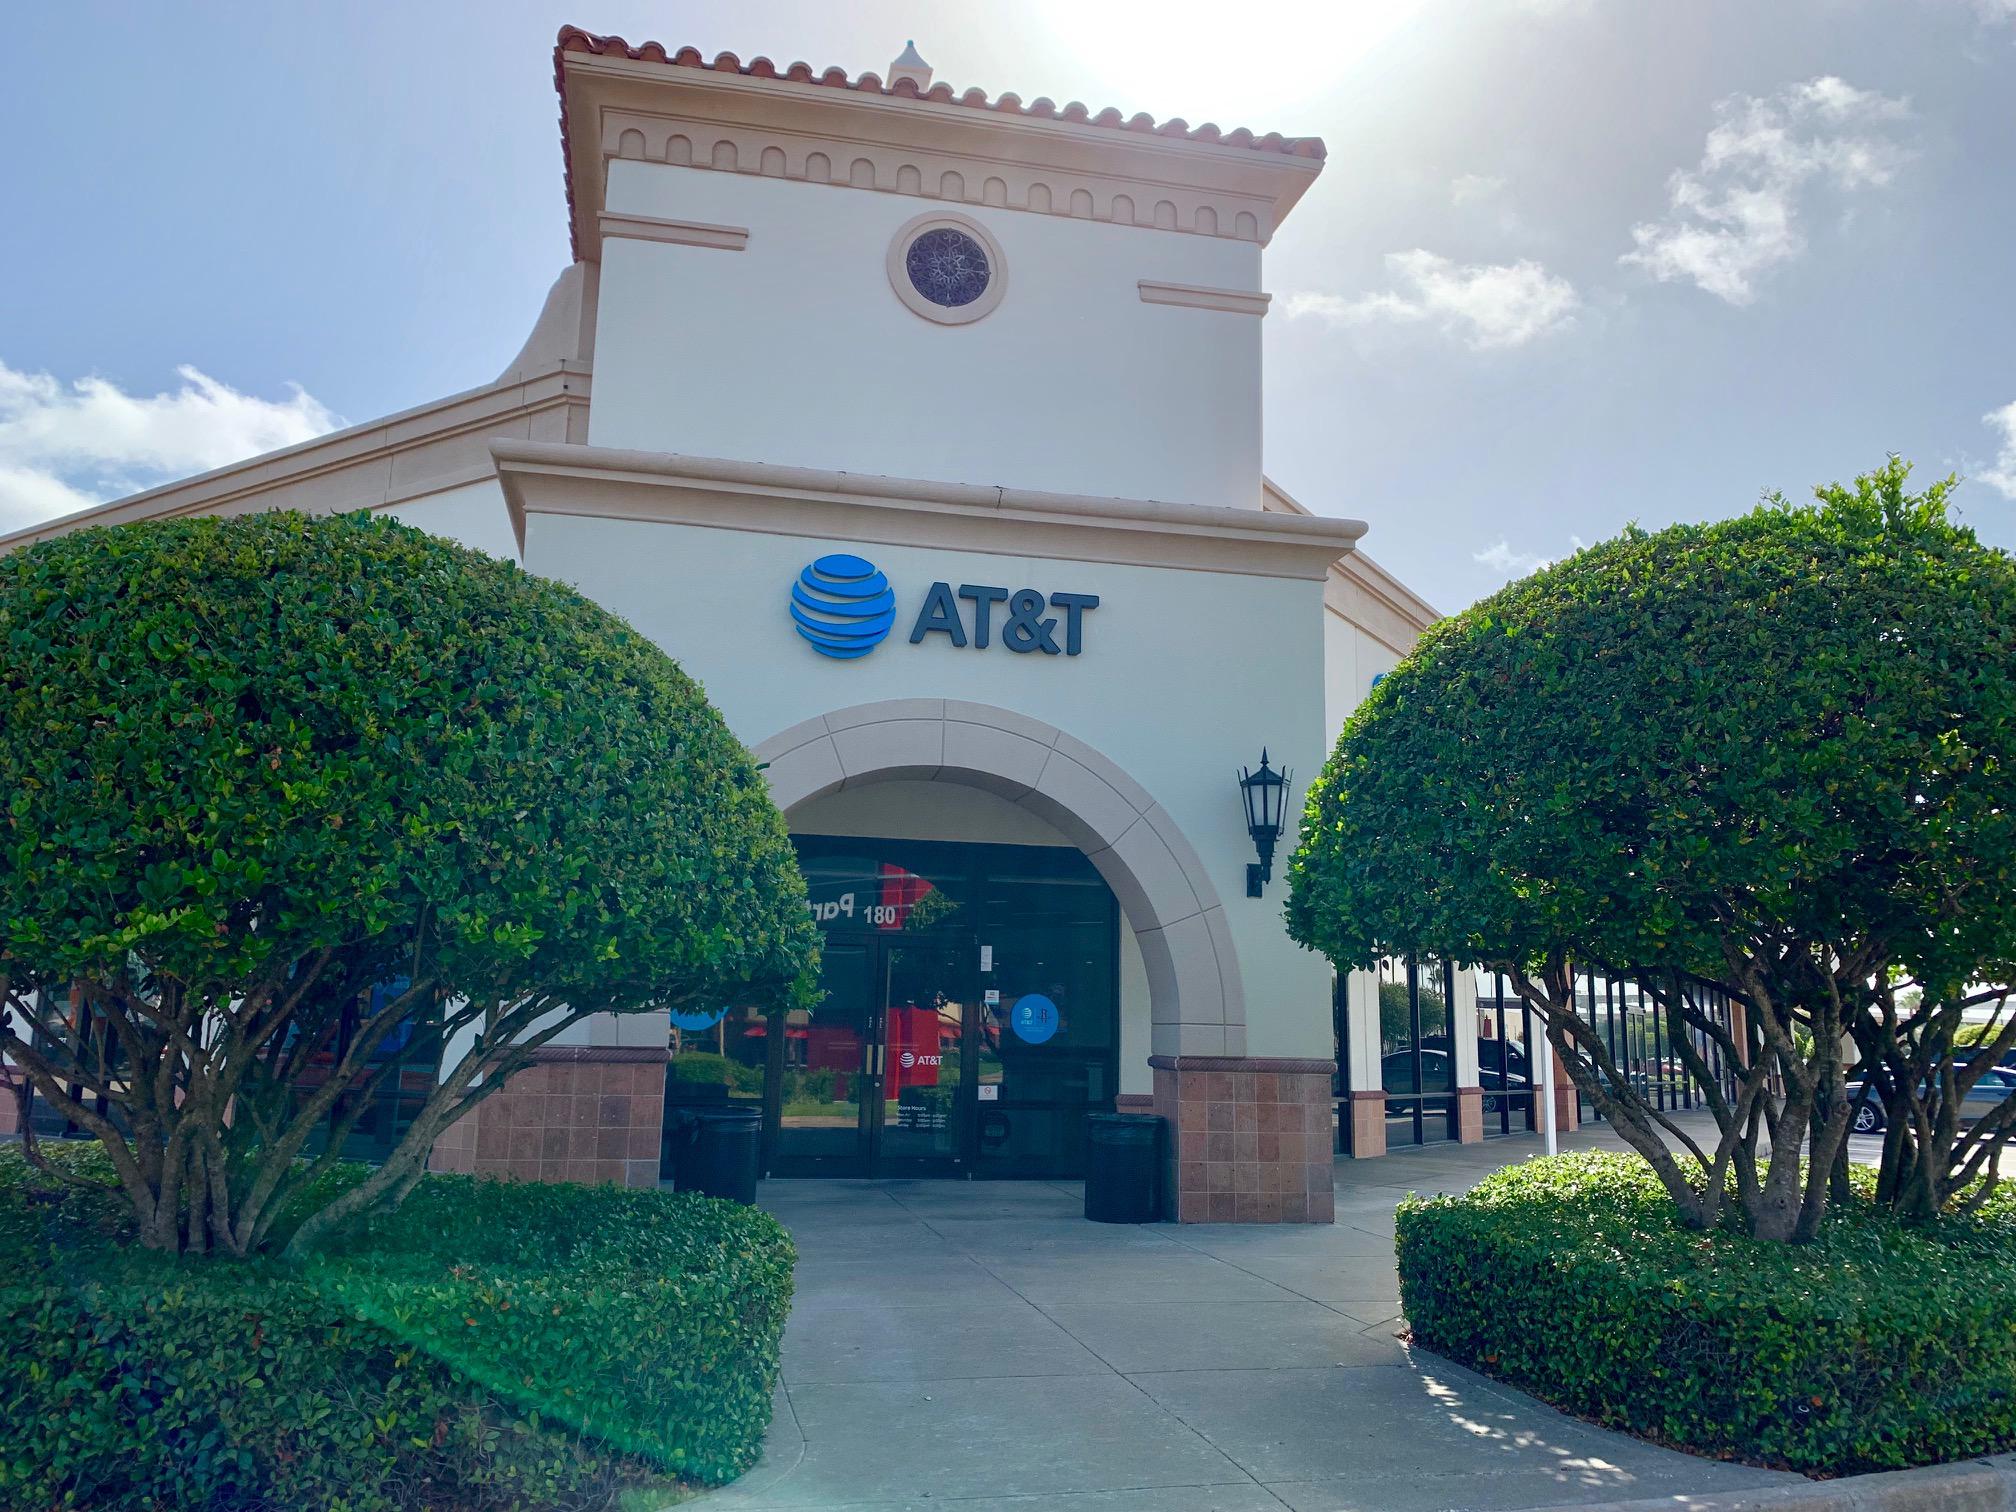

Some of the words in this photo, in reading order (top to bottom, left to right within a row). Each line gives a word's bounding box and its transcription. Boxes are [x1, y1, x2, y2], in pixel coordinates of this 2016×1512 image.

[909, 581, 1100, 656] AT&T
[864, 905, 895, 924] 180
[917, 1055, 943, 1066] AT&T
